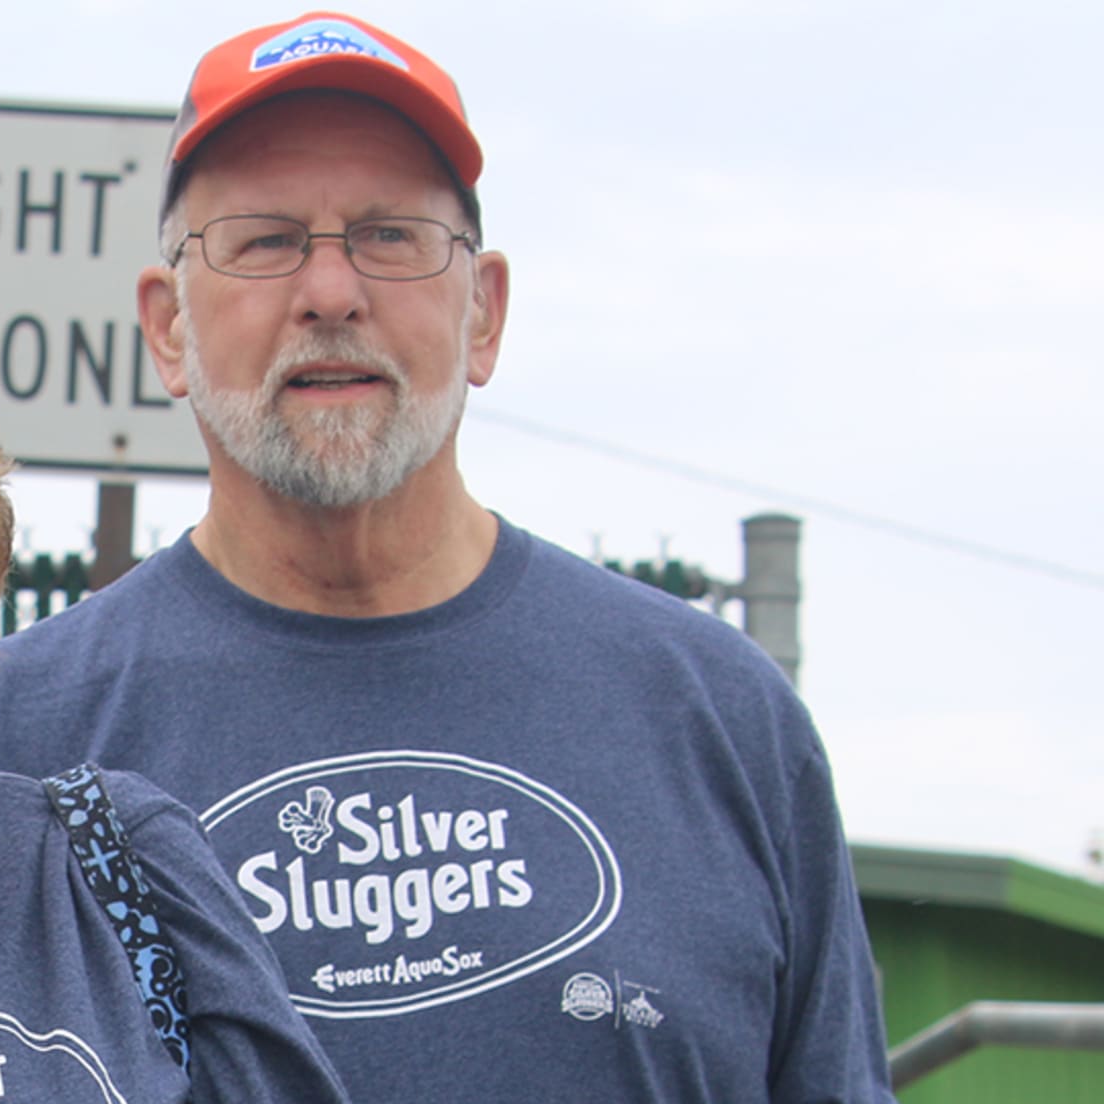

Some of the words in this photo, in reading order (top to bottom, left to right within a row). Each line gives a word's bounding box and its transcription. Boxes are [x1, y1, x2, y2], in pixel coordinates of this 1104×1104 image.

[0, 314, 173, 408] ONL
[336, 793, 509, 866] Silver
[237, 850, 534, 944] Sluggers
[311, 963, 391, 993] Everett
[392, 945, 484, 985] AquaSox
